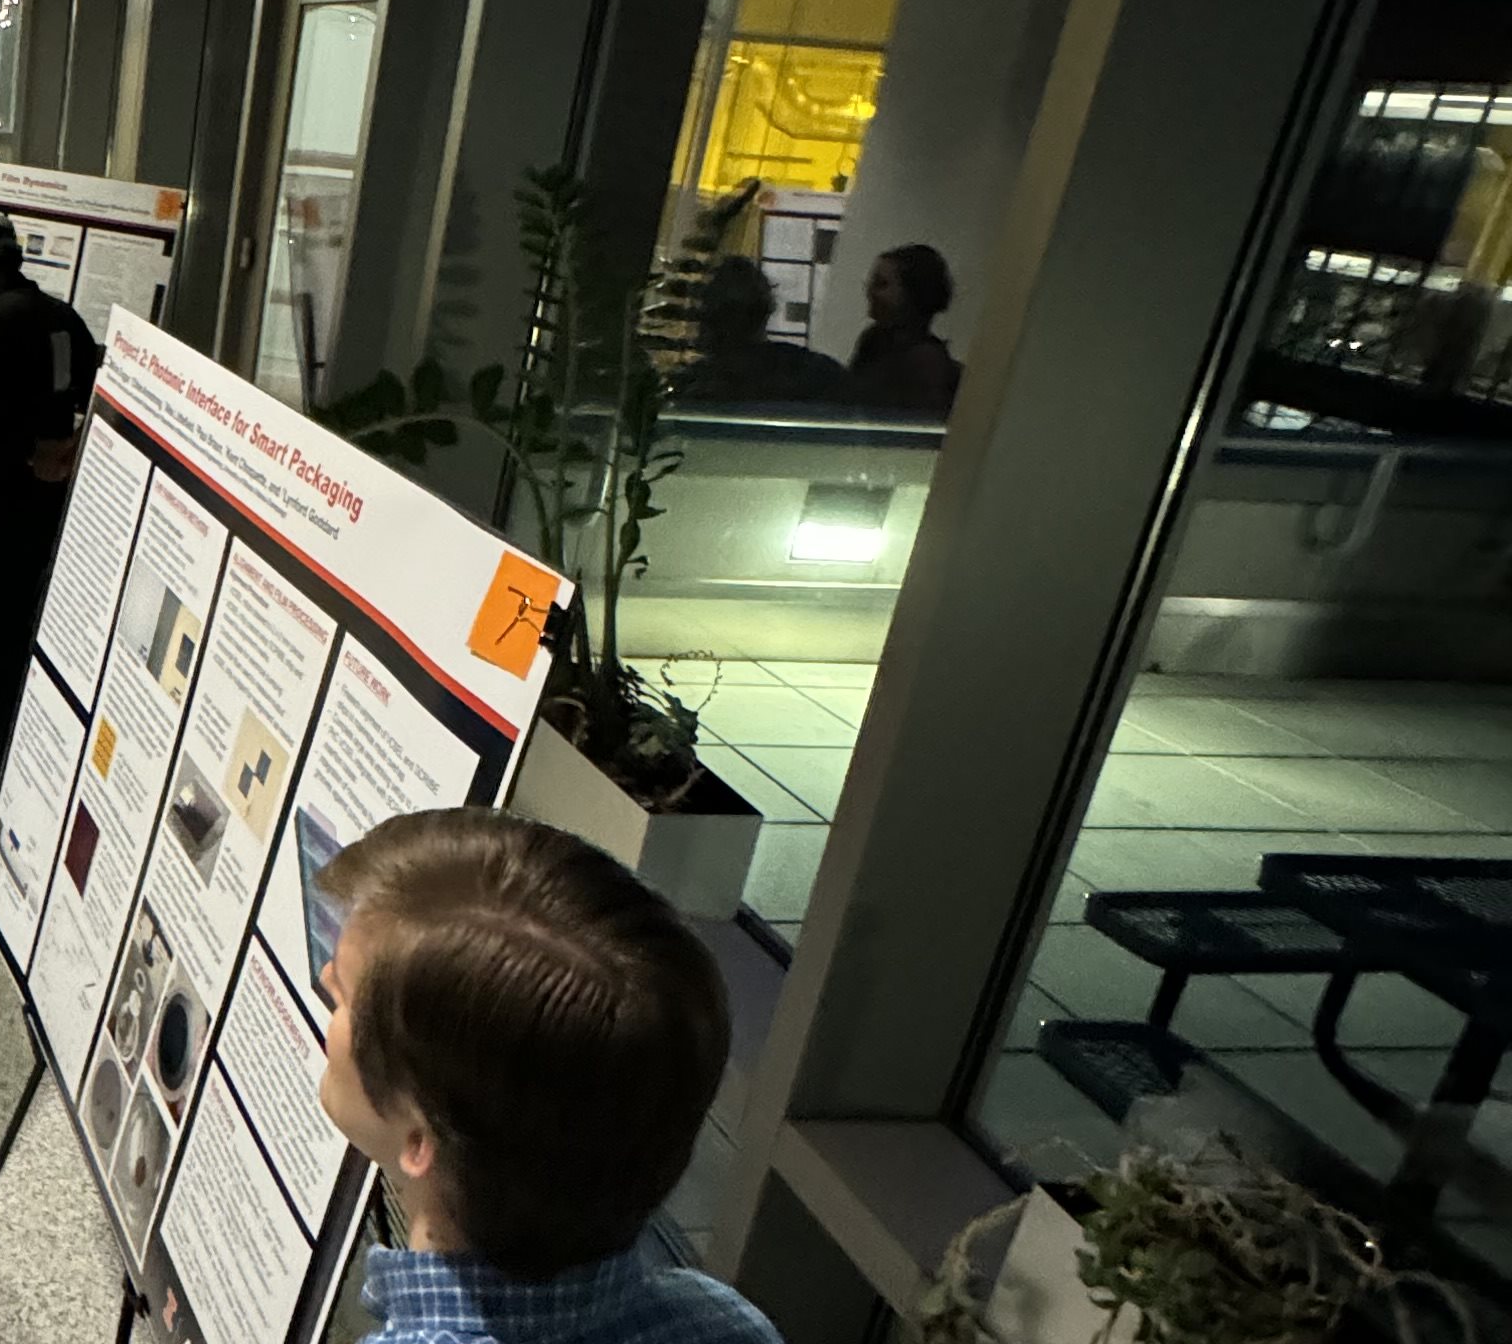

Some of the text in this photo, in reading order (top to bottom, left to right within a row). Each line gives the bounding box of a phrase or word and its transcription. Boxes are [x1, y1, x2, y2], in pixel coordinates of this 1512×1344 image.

[2, 172, 20, 185] Film
[148, 353, 186, 394] Photonic
[185, 379, 231, 426] Interface
[231, 409, 250, 438] for
[249, 422, 290, 466] Smart
[288, 447, 364, 524] Packaging
